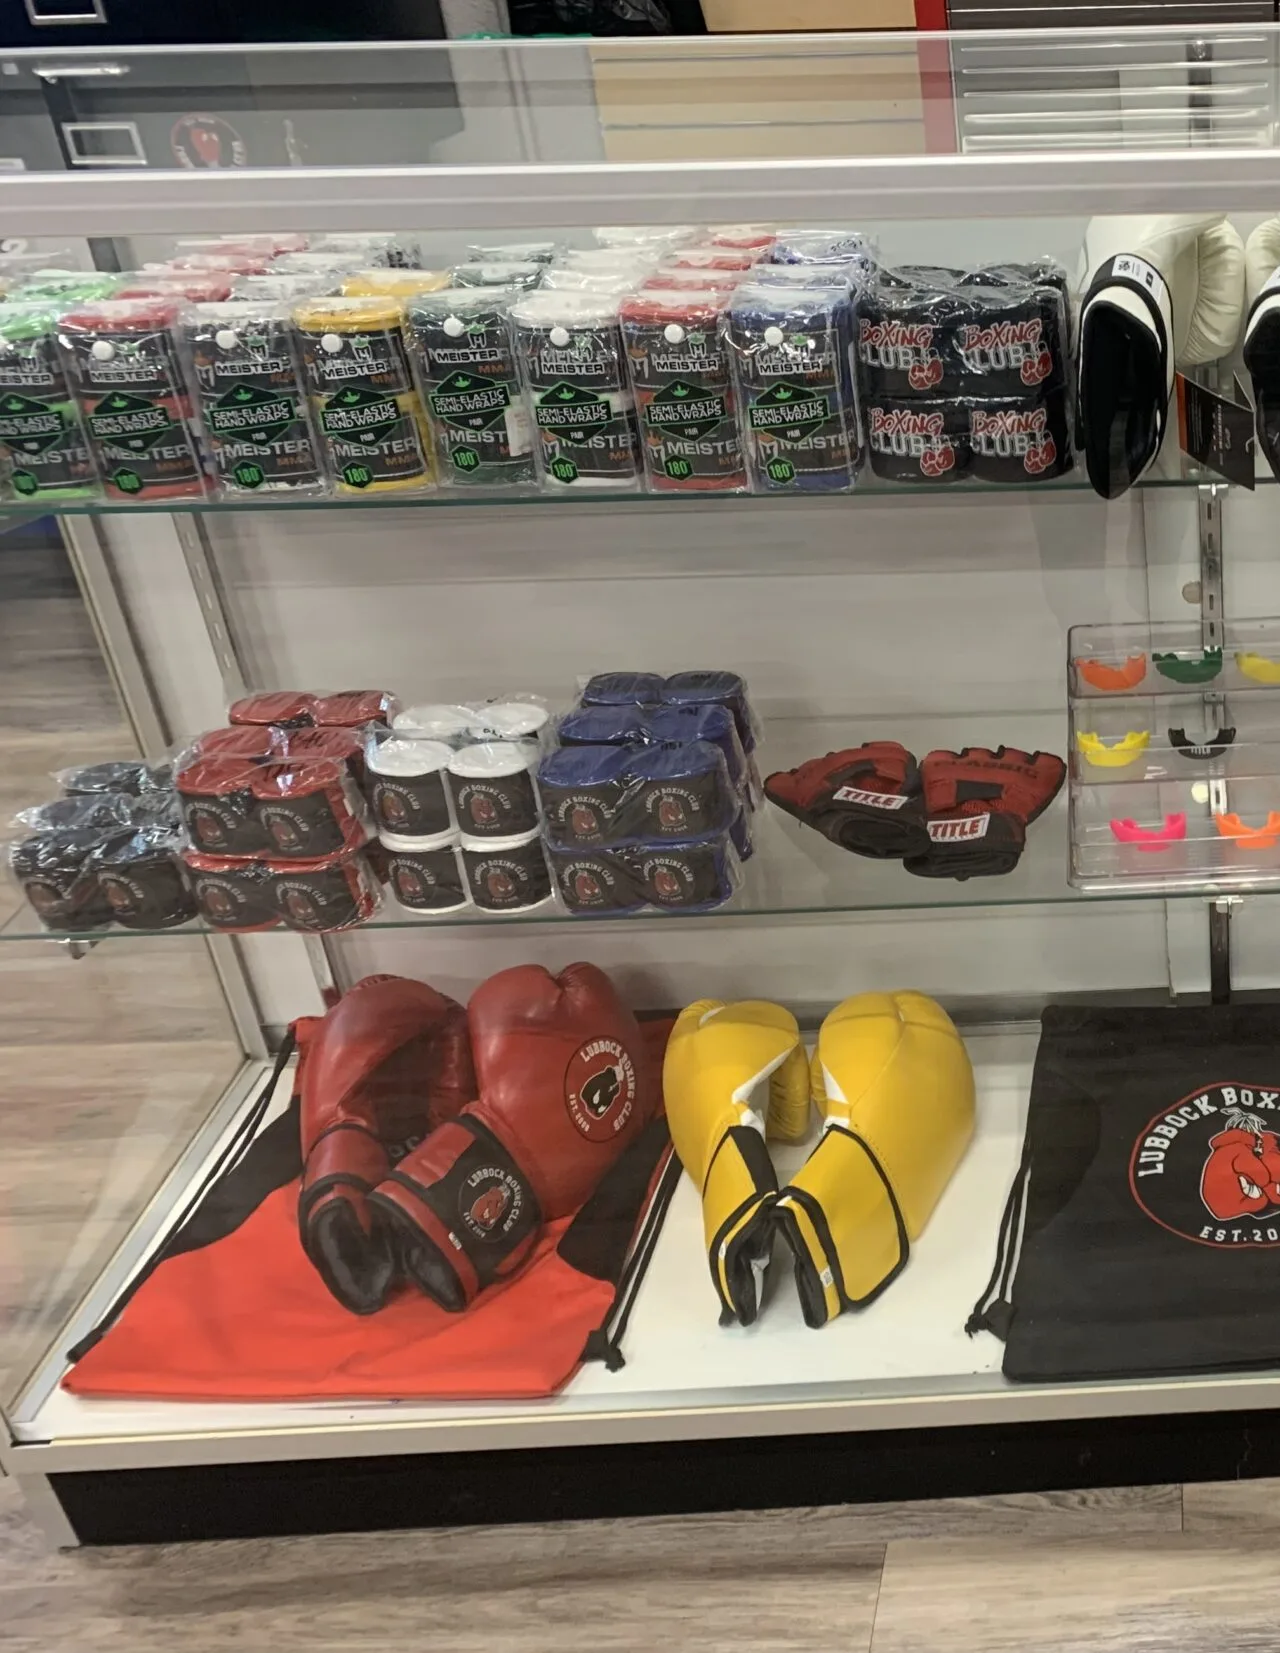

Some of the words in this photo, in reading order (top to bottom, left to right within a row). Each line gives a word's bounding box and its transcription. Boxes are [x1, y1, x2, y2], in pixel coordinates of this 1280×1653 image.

[860, 318, 933, 348] BOXING
[963, 318, 1042, 350] BOXING
[437, 350, 498, 362] MEISTER
[217, 362, 280, 374] MEISTER
[323, 363, 386, 378] MEISTER
[543, 363, 603, 374] MEISTER
[656, 360, 718, 371] MEISTER
[760, 363, 821, 373] MEISTER
[0, 375, 50, 384] EISTER
[91, 371, 153, 382] MEISTER
[435, 388, 504, 405] SEMI-ELASTIC
[214, 402, 289, 420] SEMI-ELASTIC
[324, 402, 395, 421] SEMI-ELASTIC
[436, 404, 462, 413] HAND
[466, 398, 505, 410] WRAPS
[537, 403, 607, 416] SEMI-ELASTIC
[650, 399, 722, 414] SEMI-ELASTIC
[752, 401, 824, 417] SEMI-ELASTIC
[215, 418, 247, 428] HAND
[250, 412, 290, 424] WRAPS
[326, 419, 352, 429] HAND
[356, 412, 396, 426] WRAPS
[469, 418, 482, 426] PAIR
[539, 414, 566, 424] HAND
[569, 411, 608, 422] WRAPS
[651, 412, 679, 422] HAND
[682, 408, 722, 420] WRAPS
[754, 415, 782, 426] HAND
[784, 409, 824, 422] WRAPS
[871, 407, 944, 436] BOXING
[971, 407, 1047, 436] BOXING
[451, 431, 506, 442] MEIST
[684, 428, 698, 436] PAIR
[787, 429, 800, 438] PAIR
[870, 431, 924, 458] CLUB
[970, 432, 1029, 458] CLUB
[842, 789, 898, 807] TITLE
[930, 820, 980, 838] TITLE
[580, 1040, 622, 1062] LUBBOCK
[613, 1101, 632, 1131] CLUB
[1137, 1094, 1218, 1177] LUBBOCK
[467, 1168, 505, 1187] LUBBOCK
[503, 1209, 519, 1231] CLUB
